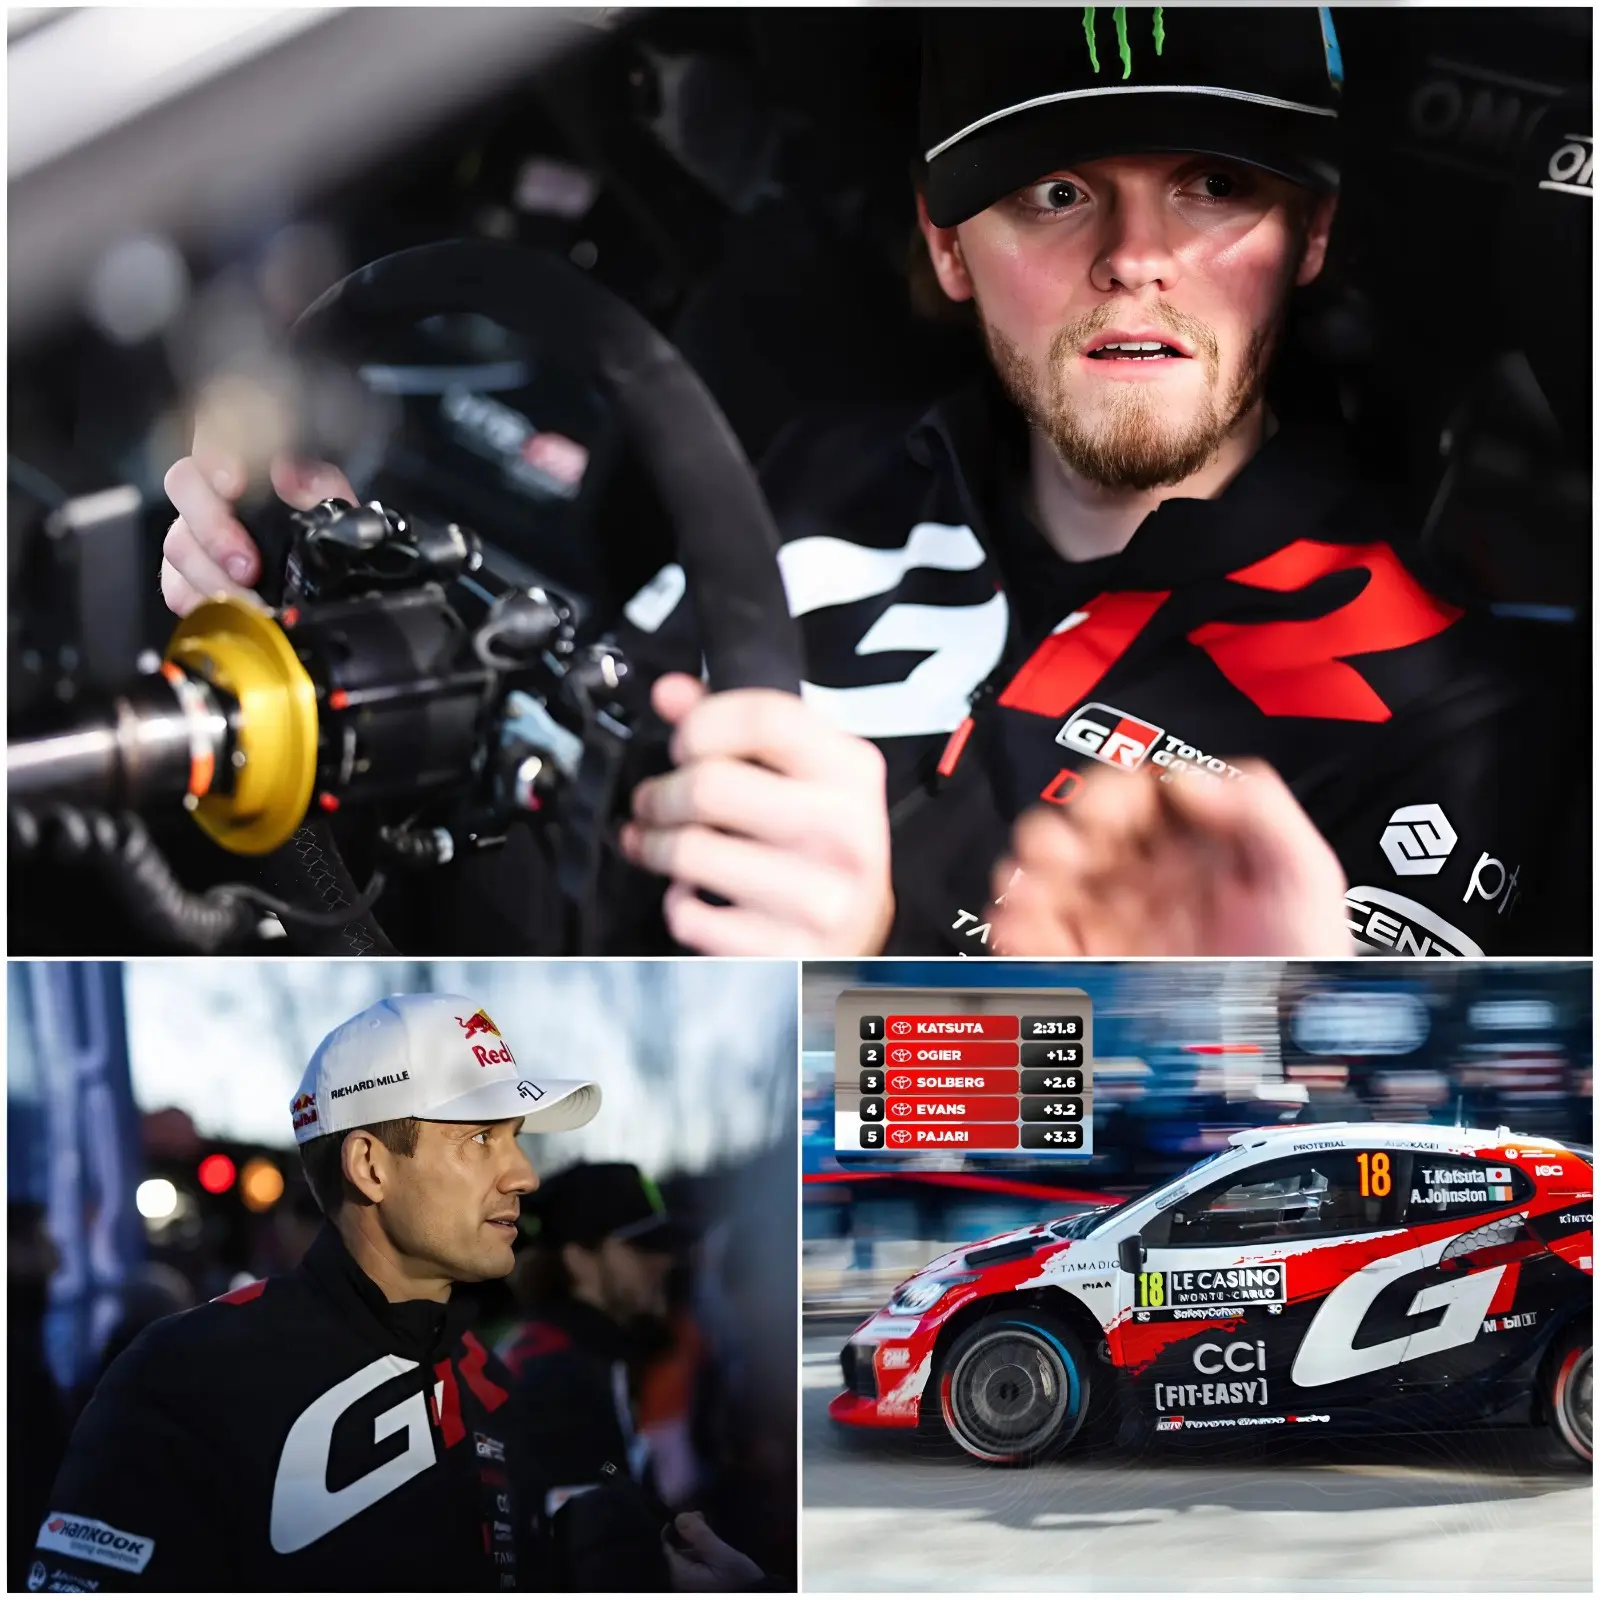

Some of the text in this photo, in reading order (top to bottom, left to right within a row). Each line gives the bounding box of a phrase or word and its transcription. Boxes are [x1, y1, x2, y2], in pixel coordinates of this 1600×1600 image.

[1064, 718, 1146, 768] GR
[331, 1070, 410, 1099] RICHARD MILLE
[1356, 1152, 1391, 1197] 18
[1411, 1187, 1487, 1204] A.Johnston
[1139, 1268, 1280, 1307] 18 LE CASINO
